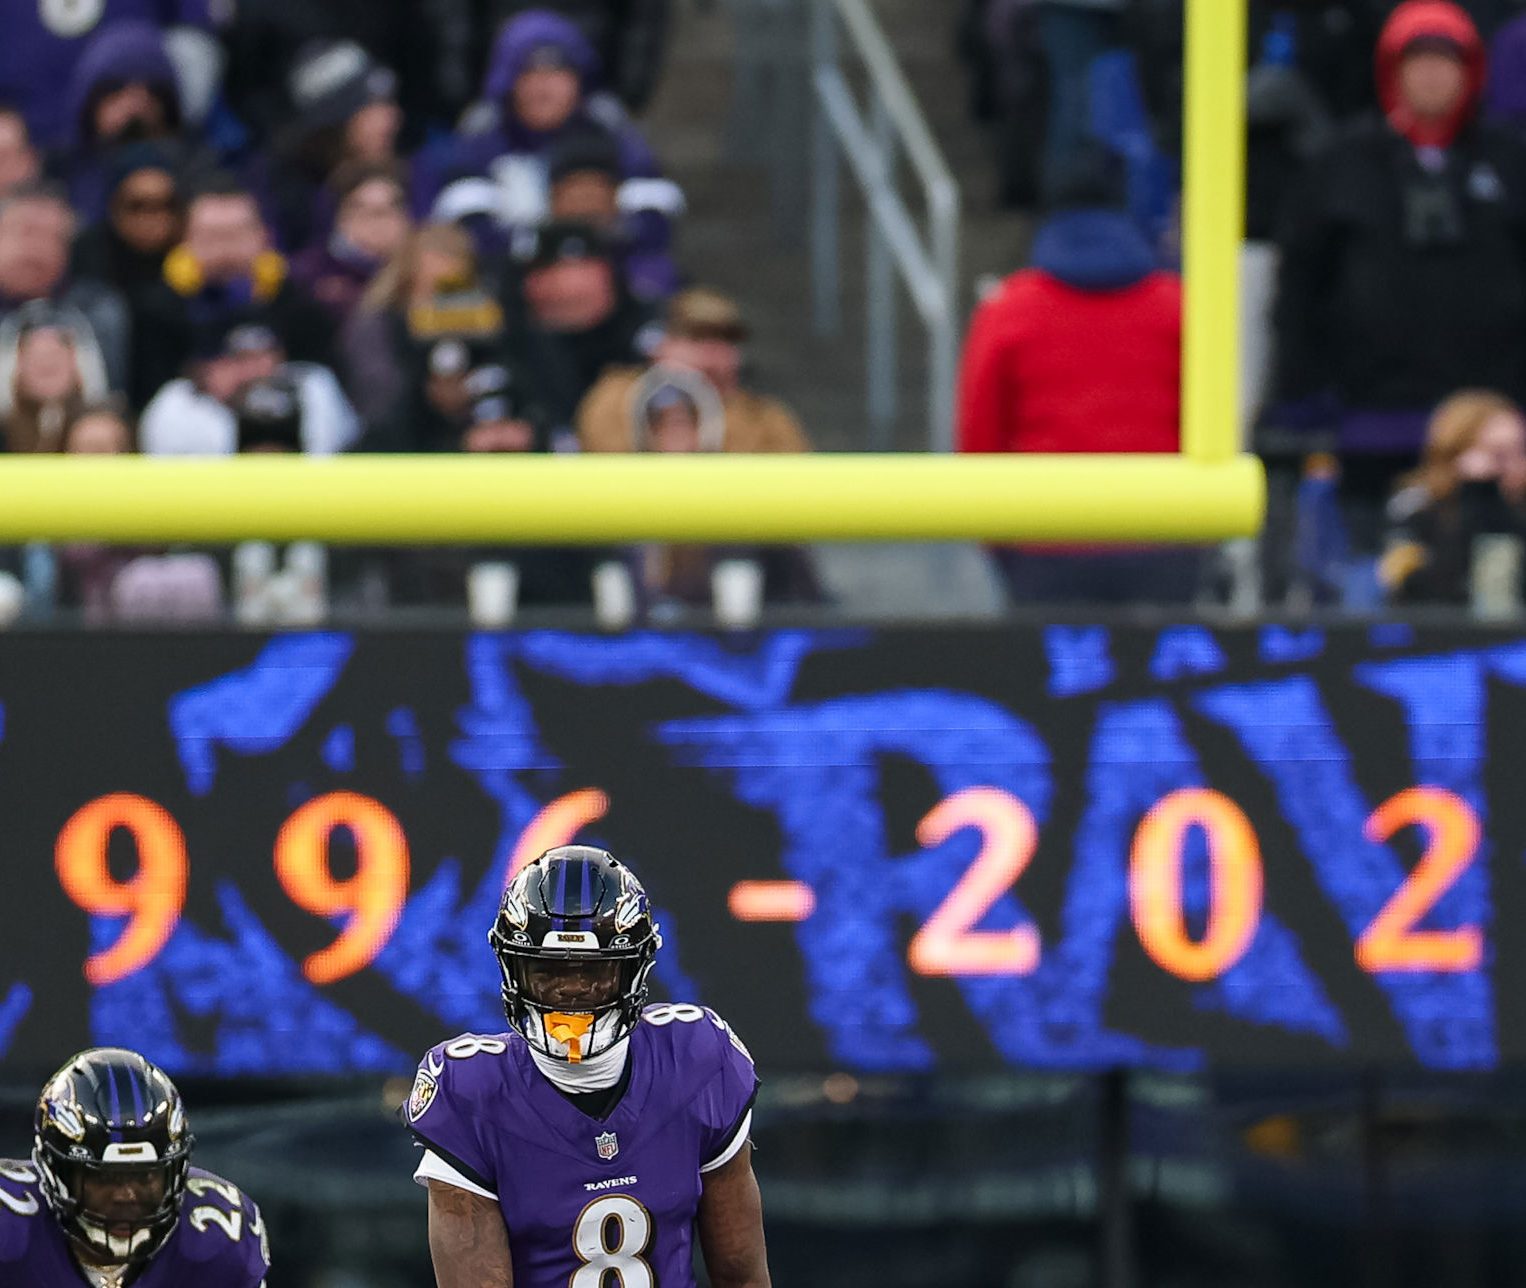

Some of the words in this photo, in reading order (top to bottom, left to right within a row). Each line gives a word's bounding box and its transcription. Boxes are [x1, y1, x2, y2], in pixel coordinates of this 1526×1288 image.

[641, 1003, 705, 1026] 8
[446, 1037, 508, 1060] 8
[584, 1175, 638, 1191] RAVENS
[185, 1176, 243, 1243] 22
